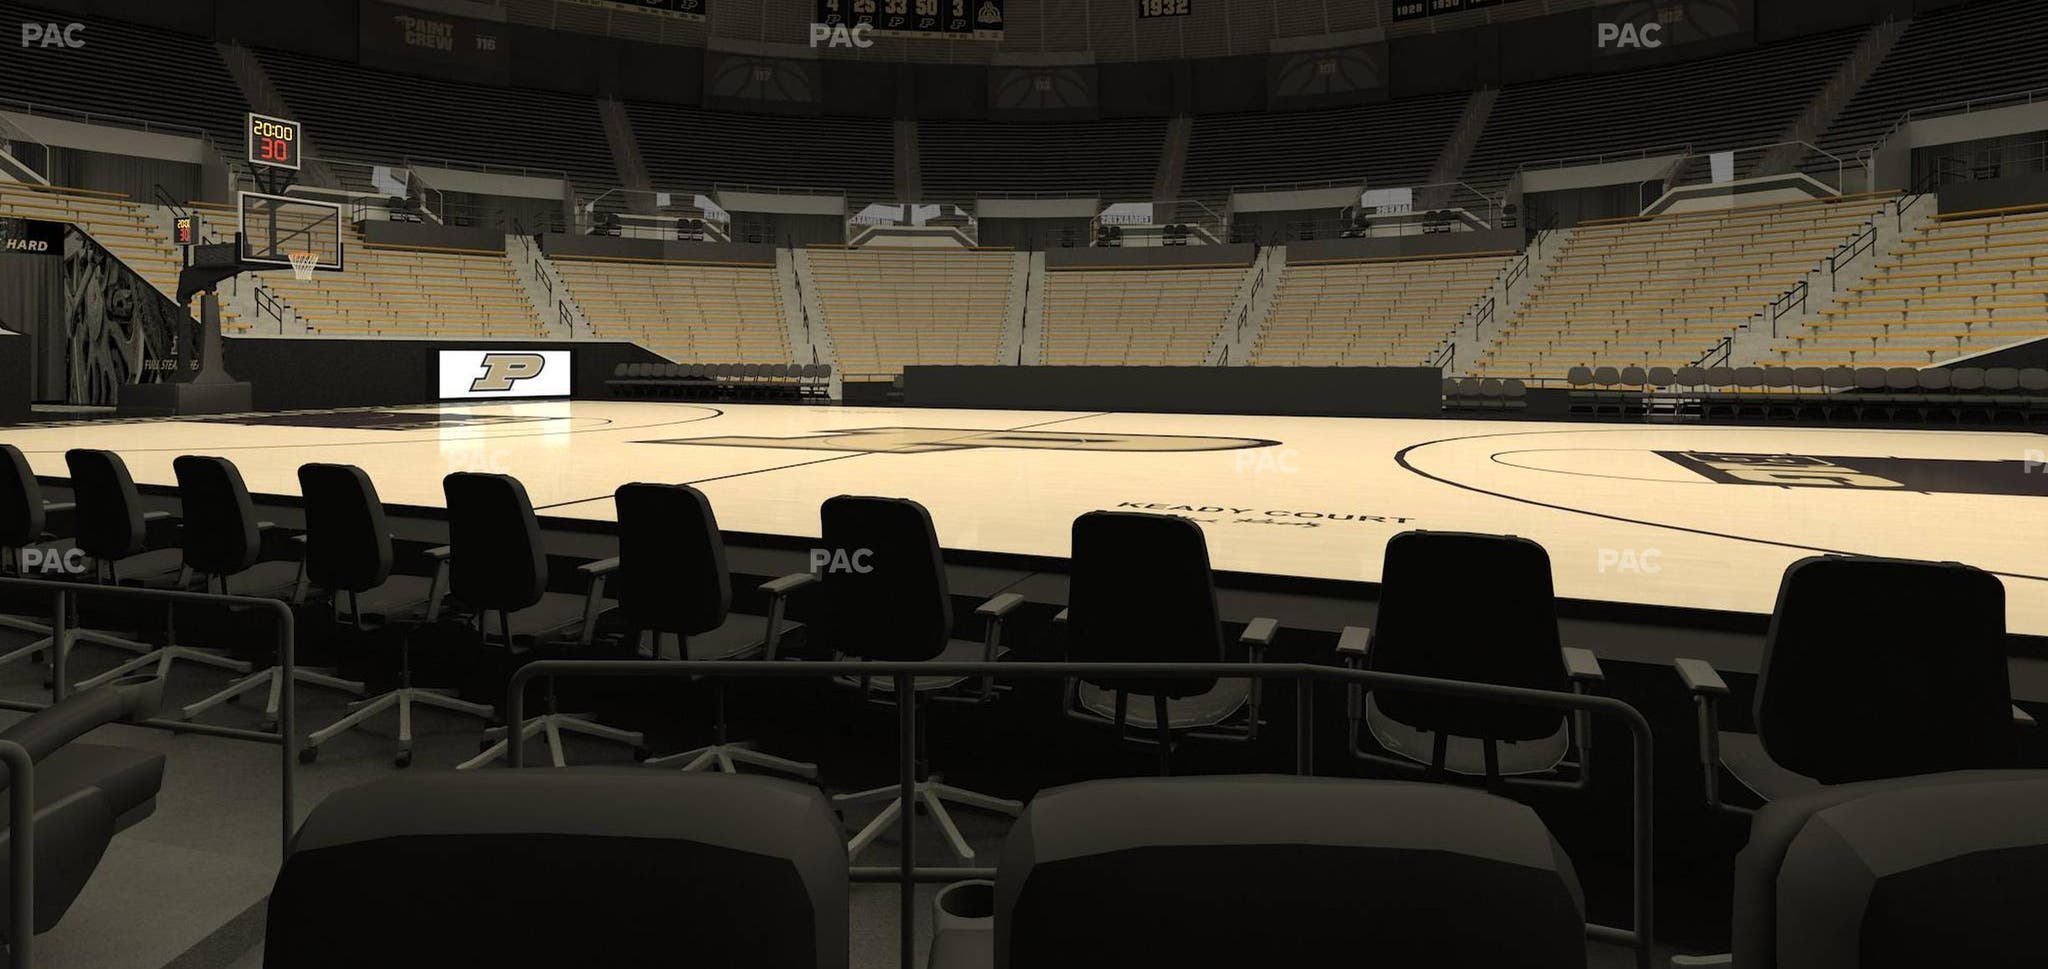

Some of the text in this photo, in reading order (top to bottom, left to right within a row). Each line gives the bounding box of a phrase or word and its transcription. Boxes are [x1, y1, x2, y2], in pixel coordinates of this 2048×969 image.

[952, 0, 964, 16] 3
[1141, 0, 1189, 17] 1932
[404, 16, 454, 37] PAINT
[404, 31, 454, 51] CREW
[253, 120, 293, 142] 20:00
[261, 137, 287, 161] 30
[6, 238, 49, 252] HARD
[469, 353, 545, 392] P
[1117, 501, 1416, 525] KEADY COURT
